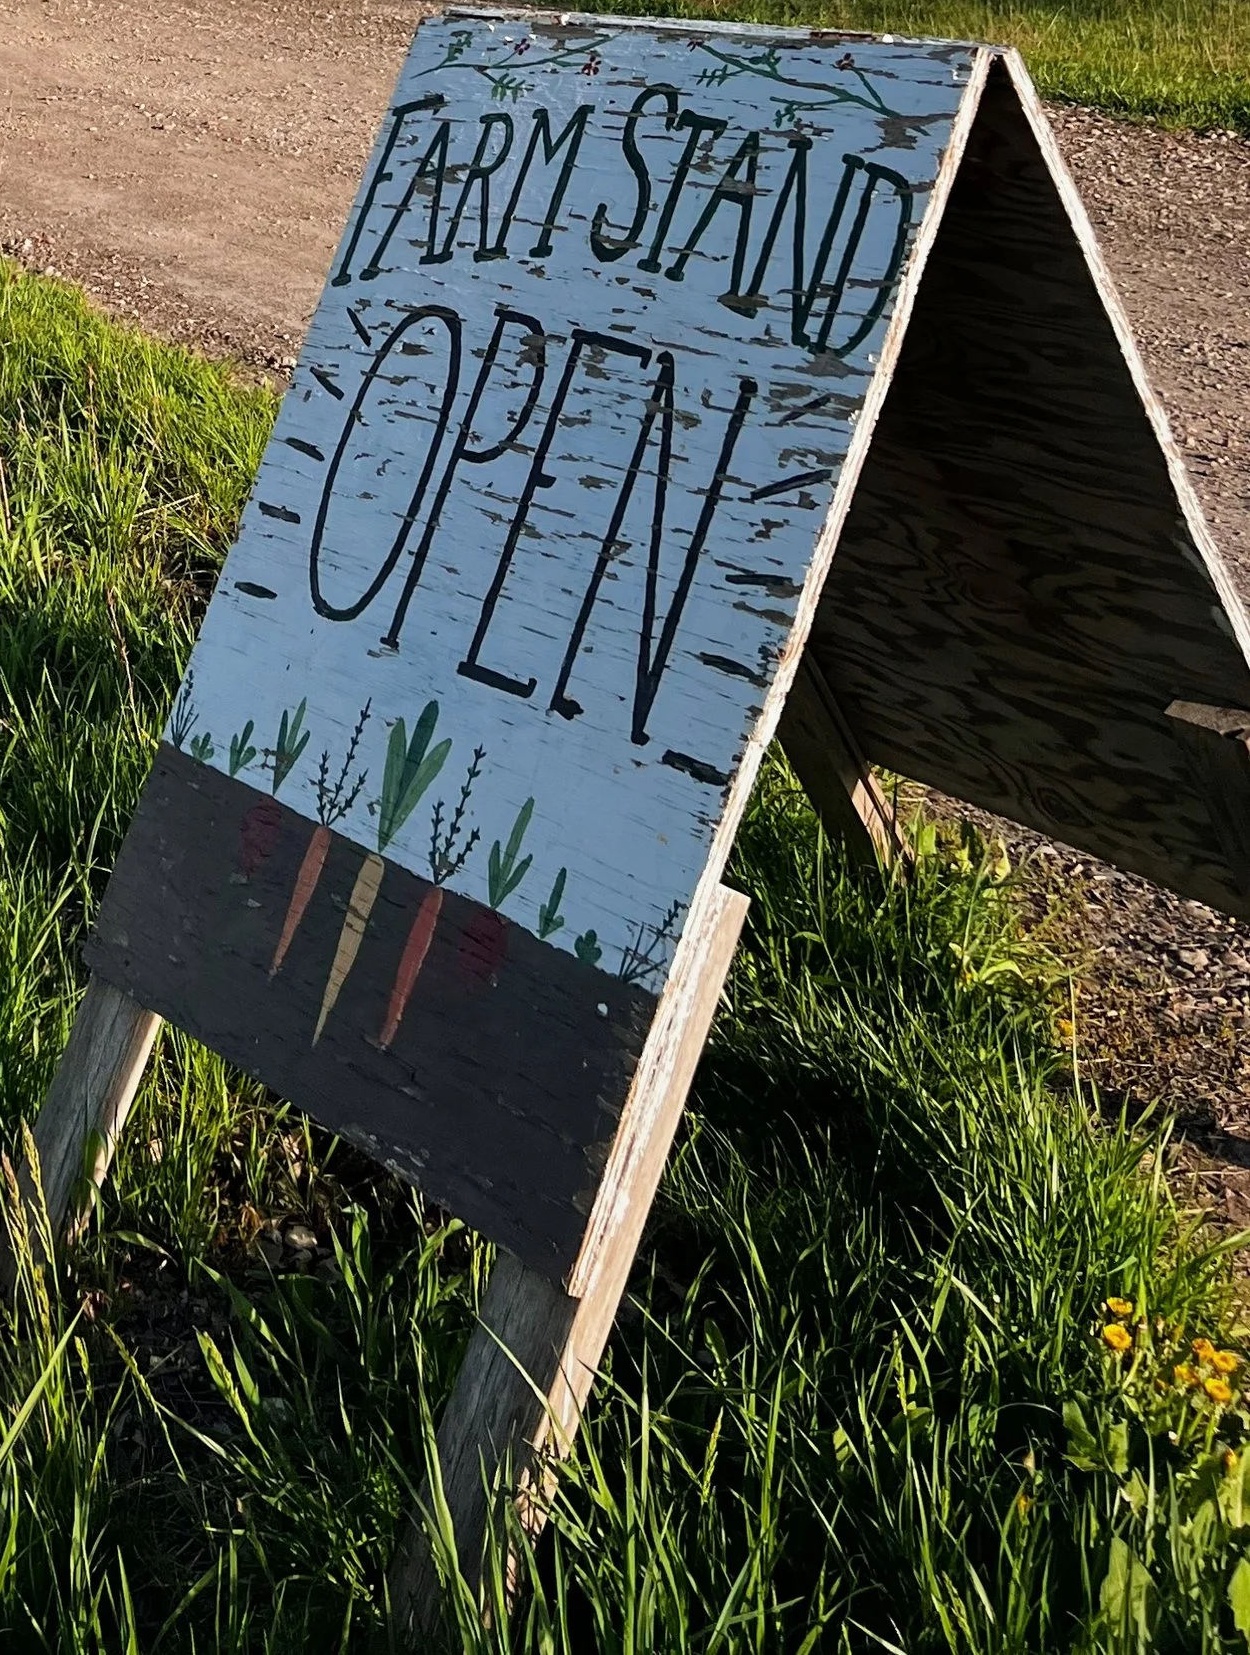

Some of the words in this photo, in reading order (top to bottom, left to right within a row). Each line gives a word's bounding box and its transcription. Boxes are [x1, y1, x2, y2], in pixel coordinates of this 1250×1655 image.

[332, 93, 595, 286] FARM
[591, 83, 913, 357] STAND
[309, 305, 758, 745] OPEN
